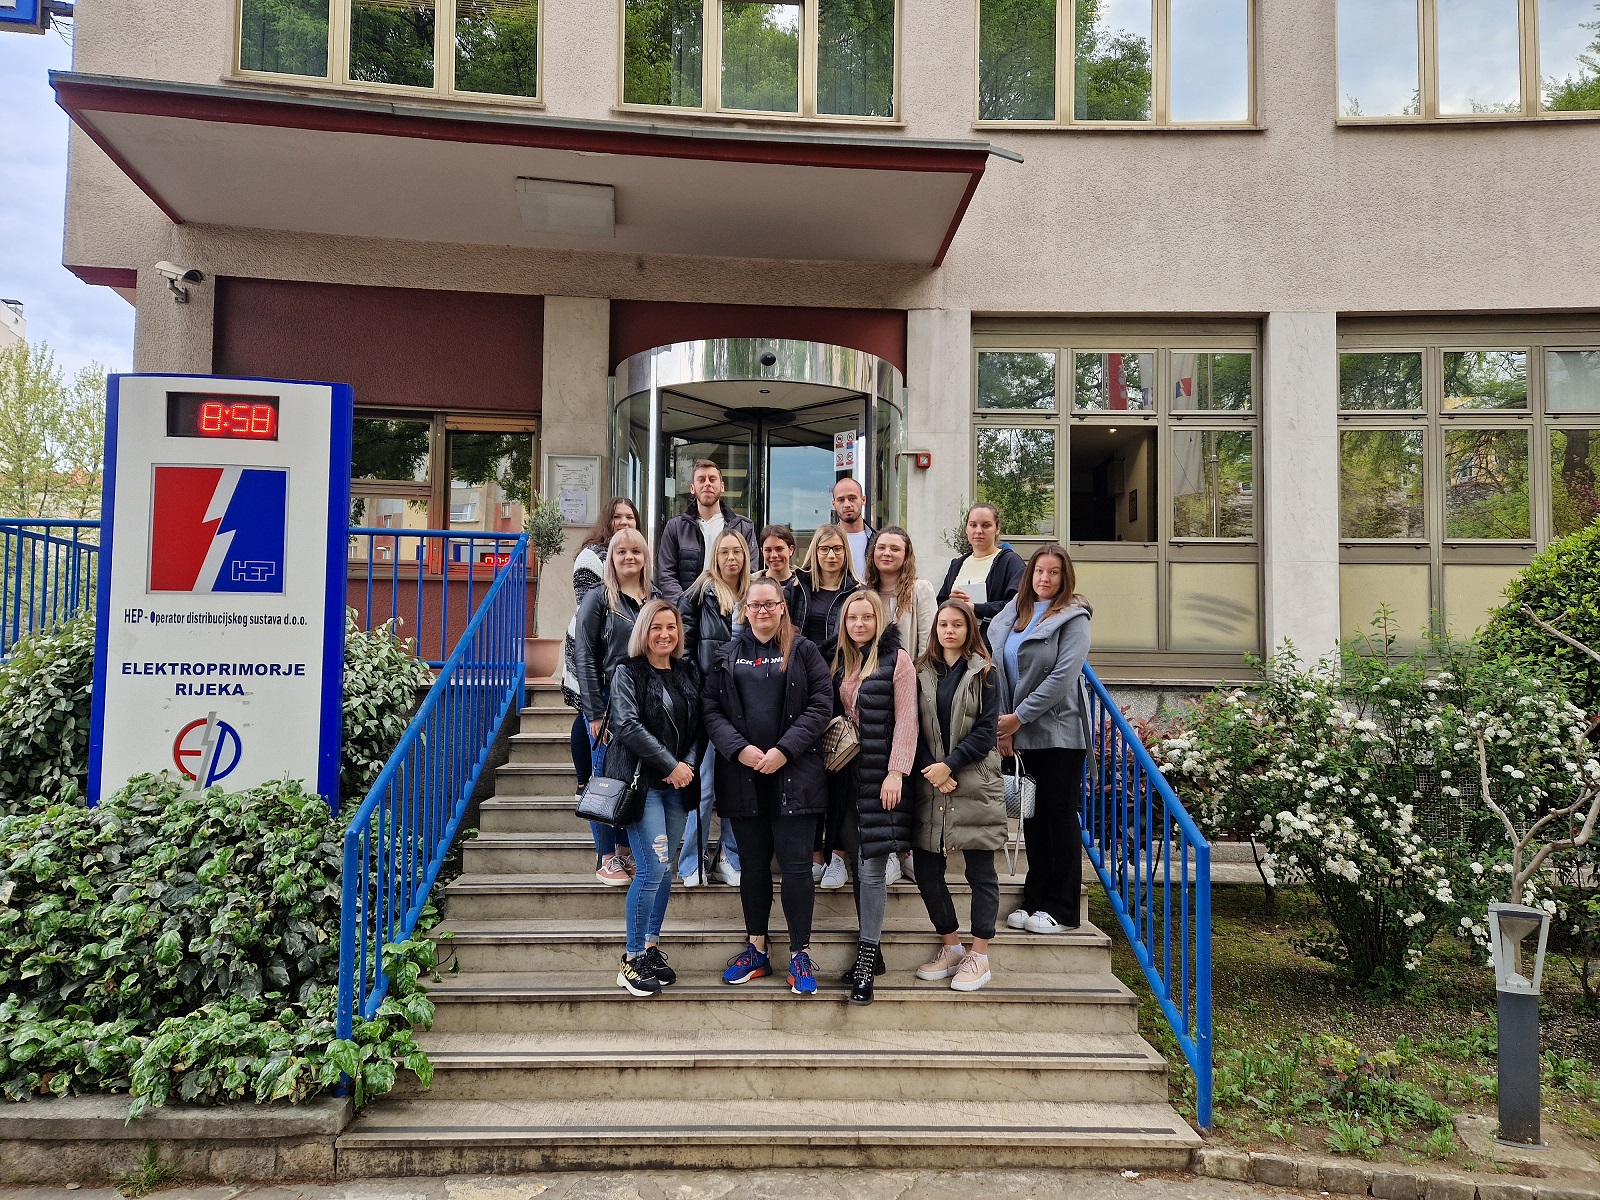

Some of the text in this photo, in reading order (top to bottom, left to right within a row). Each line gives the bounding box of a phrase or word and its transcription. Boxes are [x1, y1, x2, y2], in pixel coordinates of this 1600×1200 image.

[202, 403, 271, 433] 8:58
[231, 560, 276, 582] HEP
[124, 608, 144, 624] HEP
[150, 610, 185, 626] Operator
[186, 611, 248, 628] distribucijskog
[249, 613, 282, 625] sustava
[283, 613, 308, 626] d.o.o.
[121, 662, 306, 677] ELEKTROPRIMORJE
[735, 658, 754, 666] ACK
[175, 683, 245, 696] RIJEKA
